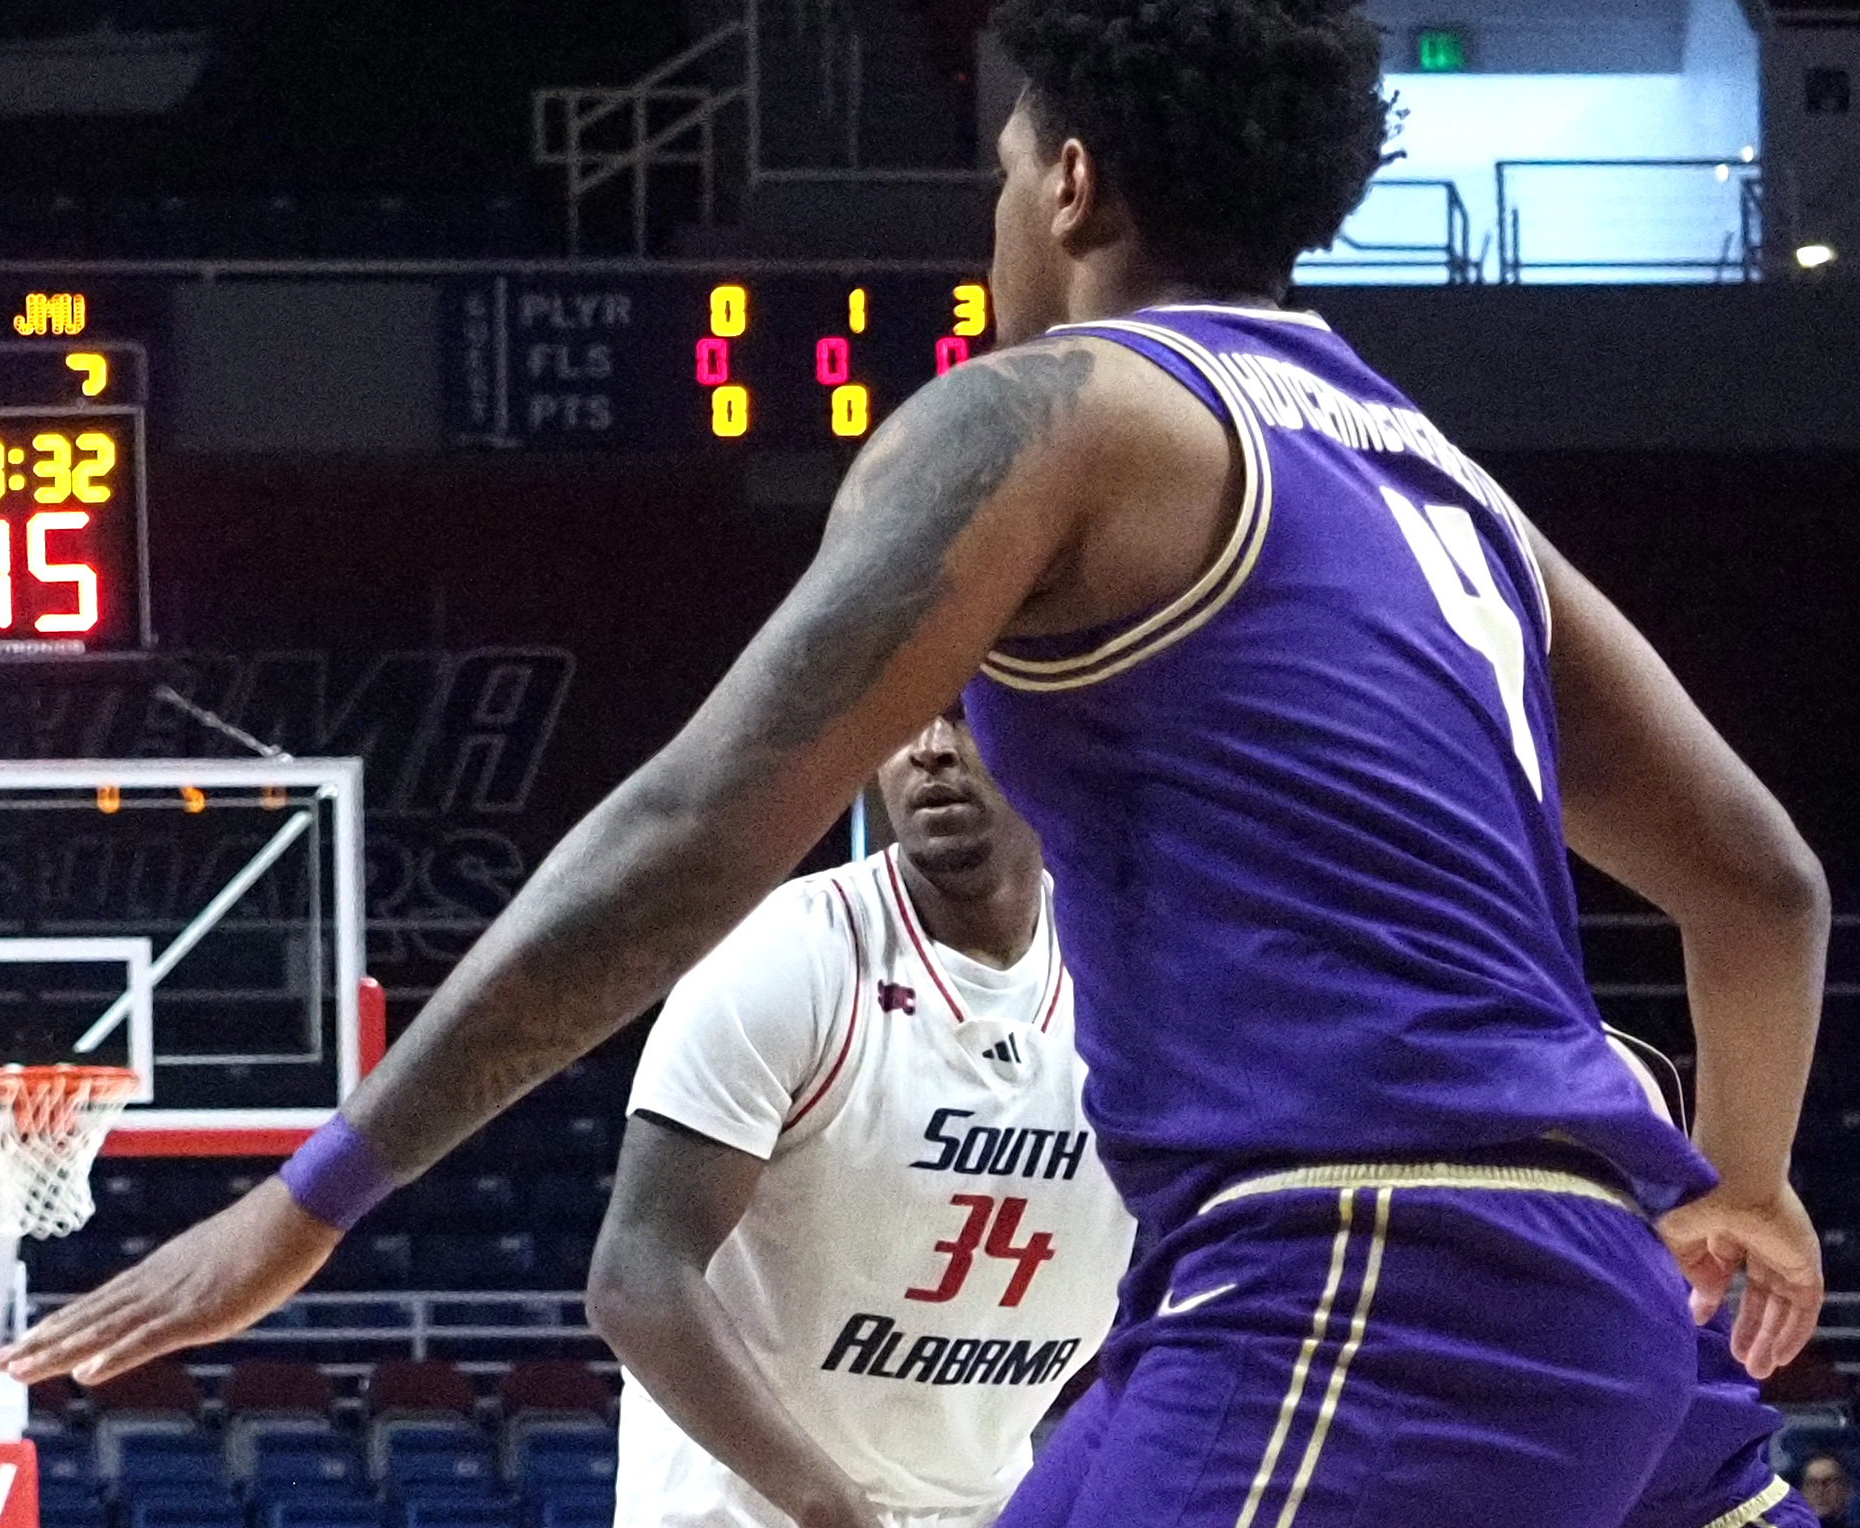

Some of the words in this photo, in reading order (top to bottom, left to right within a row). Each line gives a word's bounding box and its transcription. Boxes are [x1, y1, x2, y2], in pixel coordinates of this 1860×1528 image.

[13, 293, 86, 336] JMU
[710, 286, 747, 337] 0
[848, 288, 866, 334] 1
[952, 285, 987, 337] 3
[696, 337, 729, 386] 0
[816, 337, 849, 386] 0
[711, 386, 748, 437] 0
[831, 386, 868, 437] 0
[1380, 484, 1543, 804] 4
[908, 1106, 1089, 1180] SOUTH
[904, 1193, 1056, 1308] 34
[821, 1312, 1082, 1386] ALABAMA
